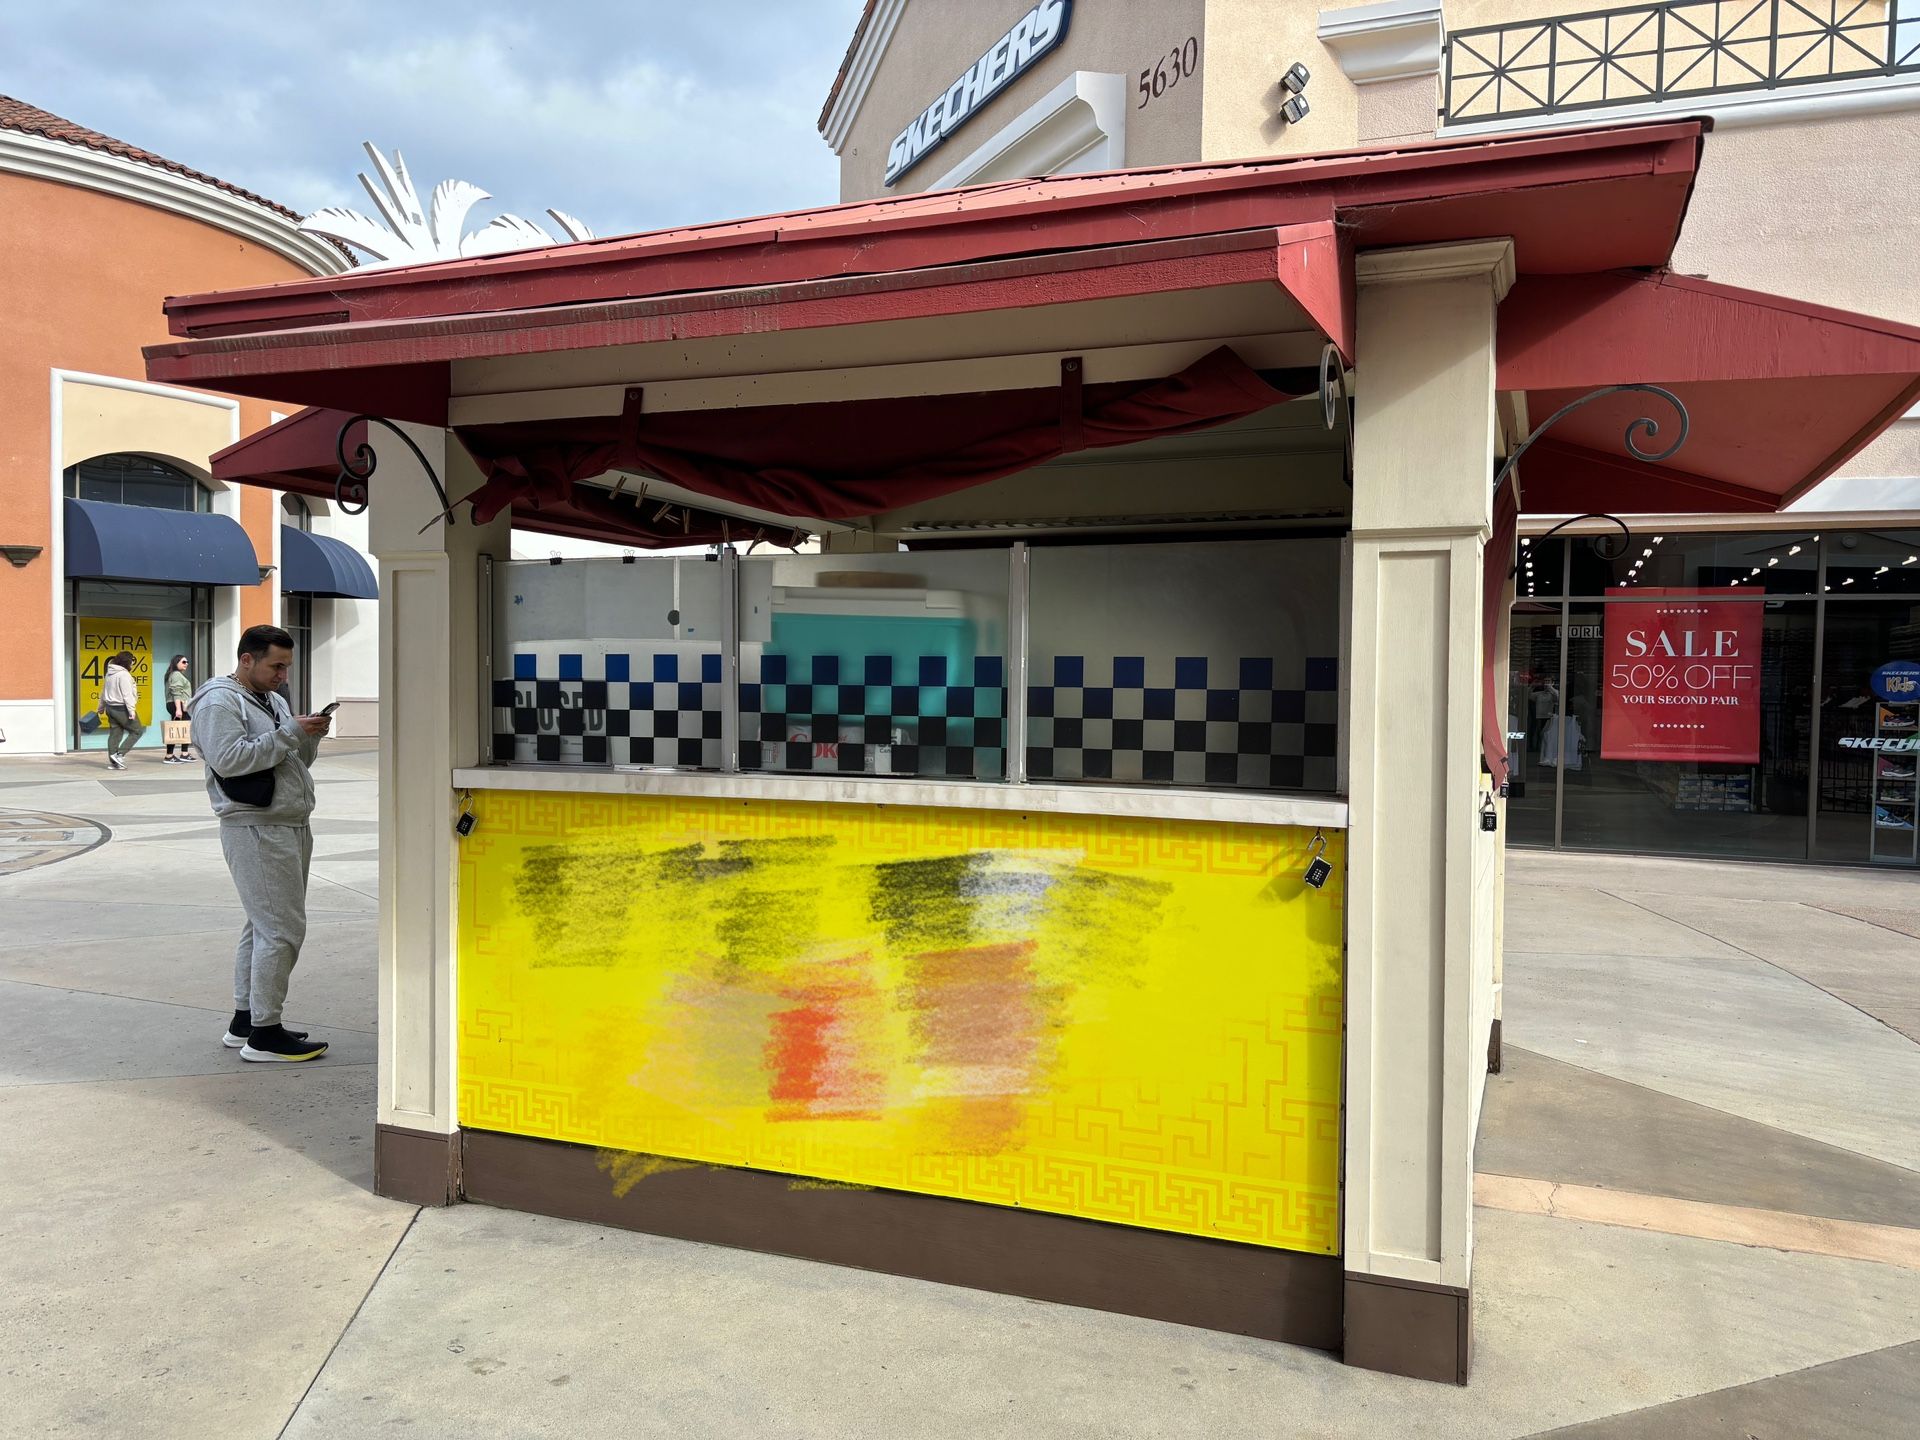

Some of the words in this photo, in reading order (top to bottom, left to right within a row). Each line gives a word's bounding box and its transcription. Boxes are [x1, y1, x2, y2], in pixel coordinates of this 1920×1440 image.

[1138, 36, 1198, 110] 5630
[884, 0, 1064, 185] SKECHERS
[84, 634, 147, 650] EXTRA
[1625, 629, 1739, 657] SALE
[80, 655, 148, 687] 4%
[1611, 664, 1679, 689] 50%
[1684, 664, 1754, 690] OFF
[1885, 676, 1915, 693] Kids
[1622, 694, 1655, 704] YOUR
[1657, 695, 1708, 705] SECOND
[1711, 696, 1739, 705] PAIR
[168, 726, 188, 739] GAP
